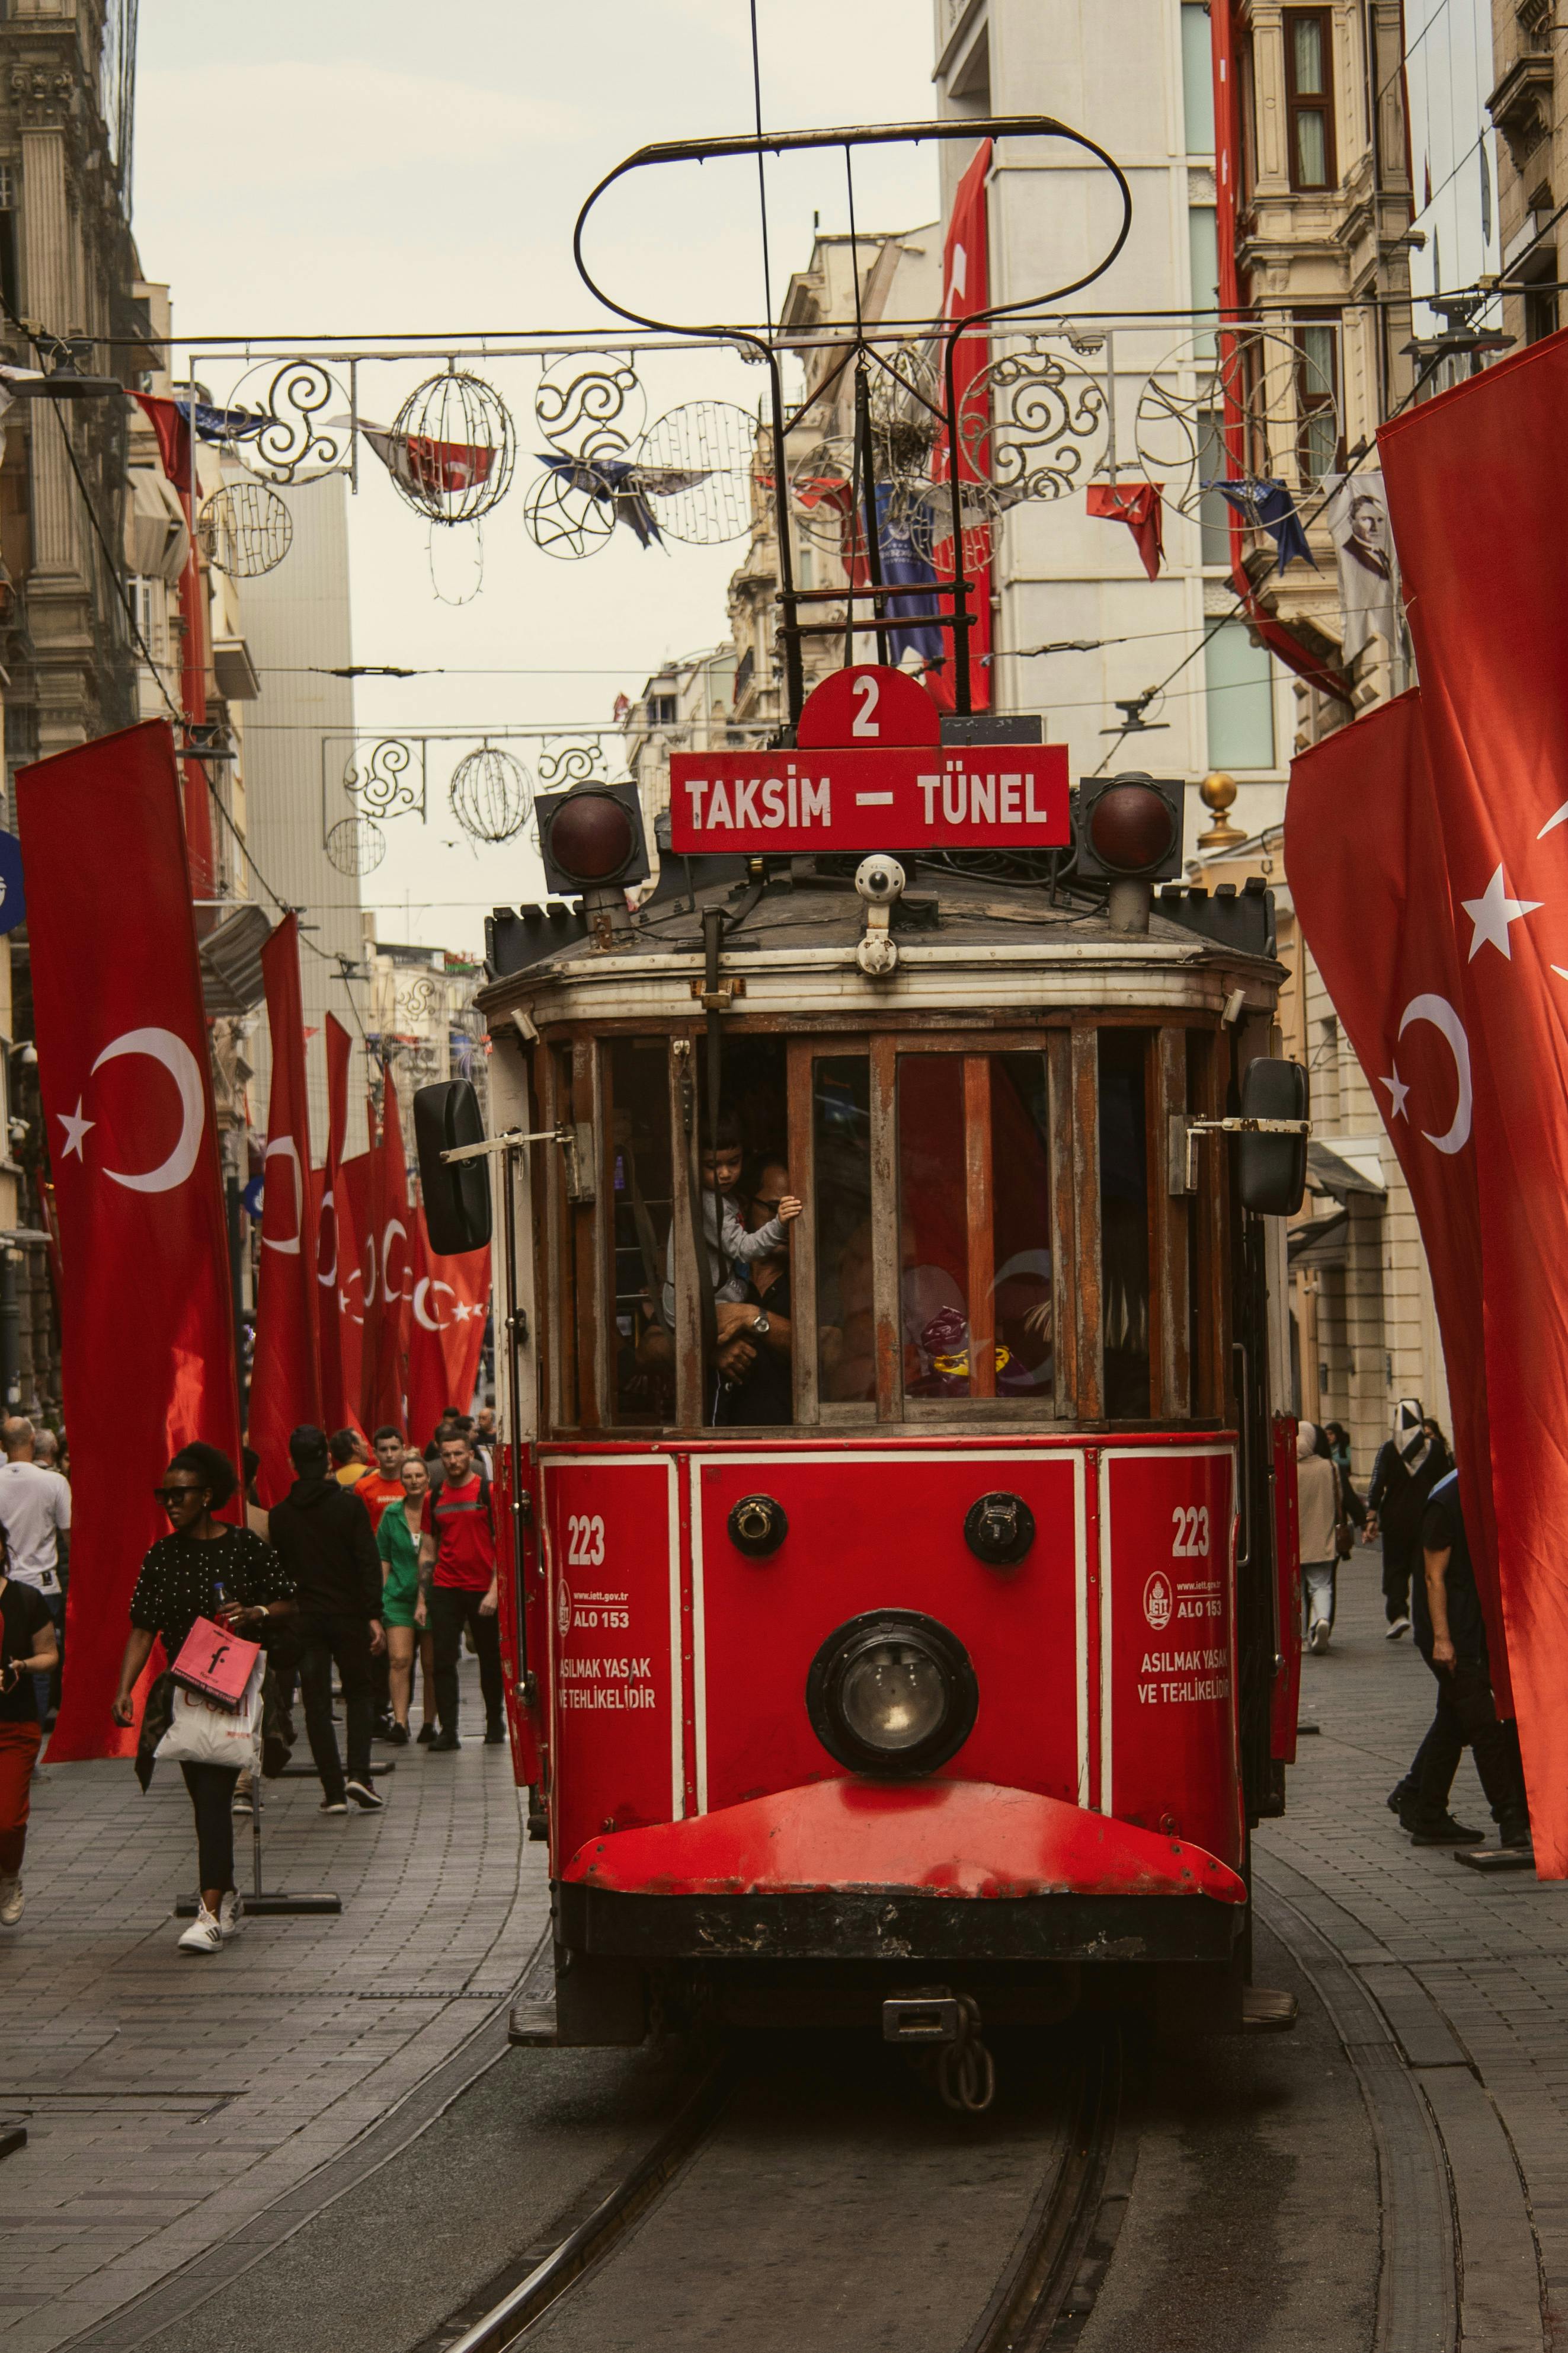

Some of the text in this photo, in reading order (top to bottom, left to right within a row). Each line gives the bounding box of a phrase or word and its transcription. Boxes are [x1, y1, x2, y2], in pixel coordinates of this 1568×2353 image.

[852, 674, 879, 737] 2
[684, 764, 831, 830] TAKSİM
[917, 760, 1047, 825] TÜNEL
[568, 1514, 605, 1566] 223
[1172, 1505, 1209, 1557] 223
[573, 1591, 629, 1603] www.iett.gov.tr
[1177, 1600, 1222, 1618] ALO 153
[574, 1611, 629, 1628] ALO 153
[560, 1658, 652, 1678] ASILMAK YASAK
[1141, 1648, 1228, 1673] ASILMAK YASAK
[184, 1690, 249, 1717] Coal
[568, 1684, 656, 1709] TEHLİKELİDİR
[1137, 1683, 1157, 1704] VE
